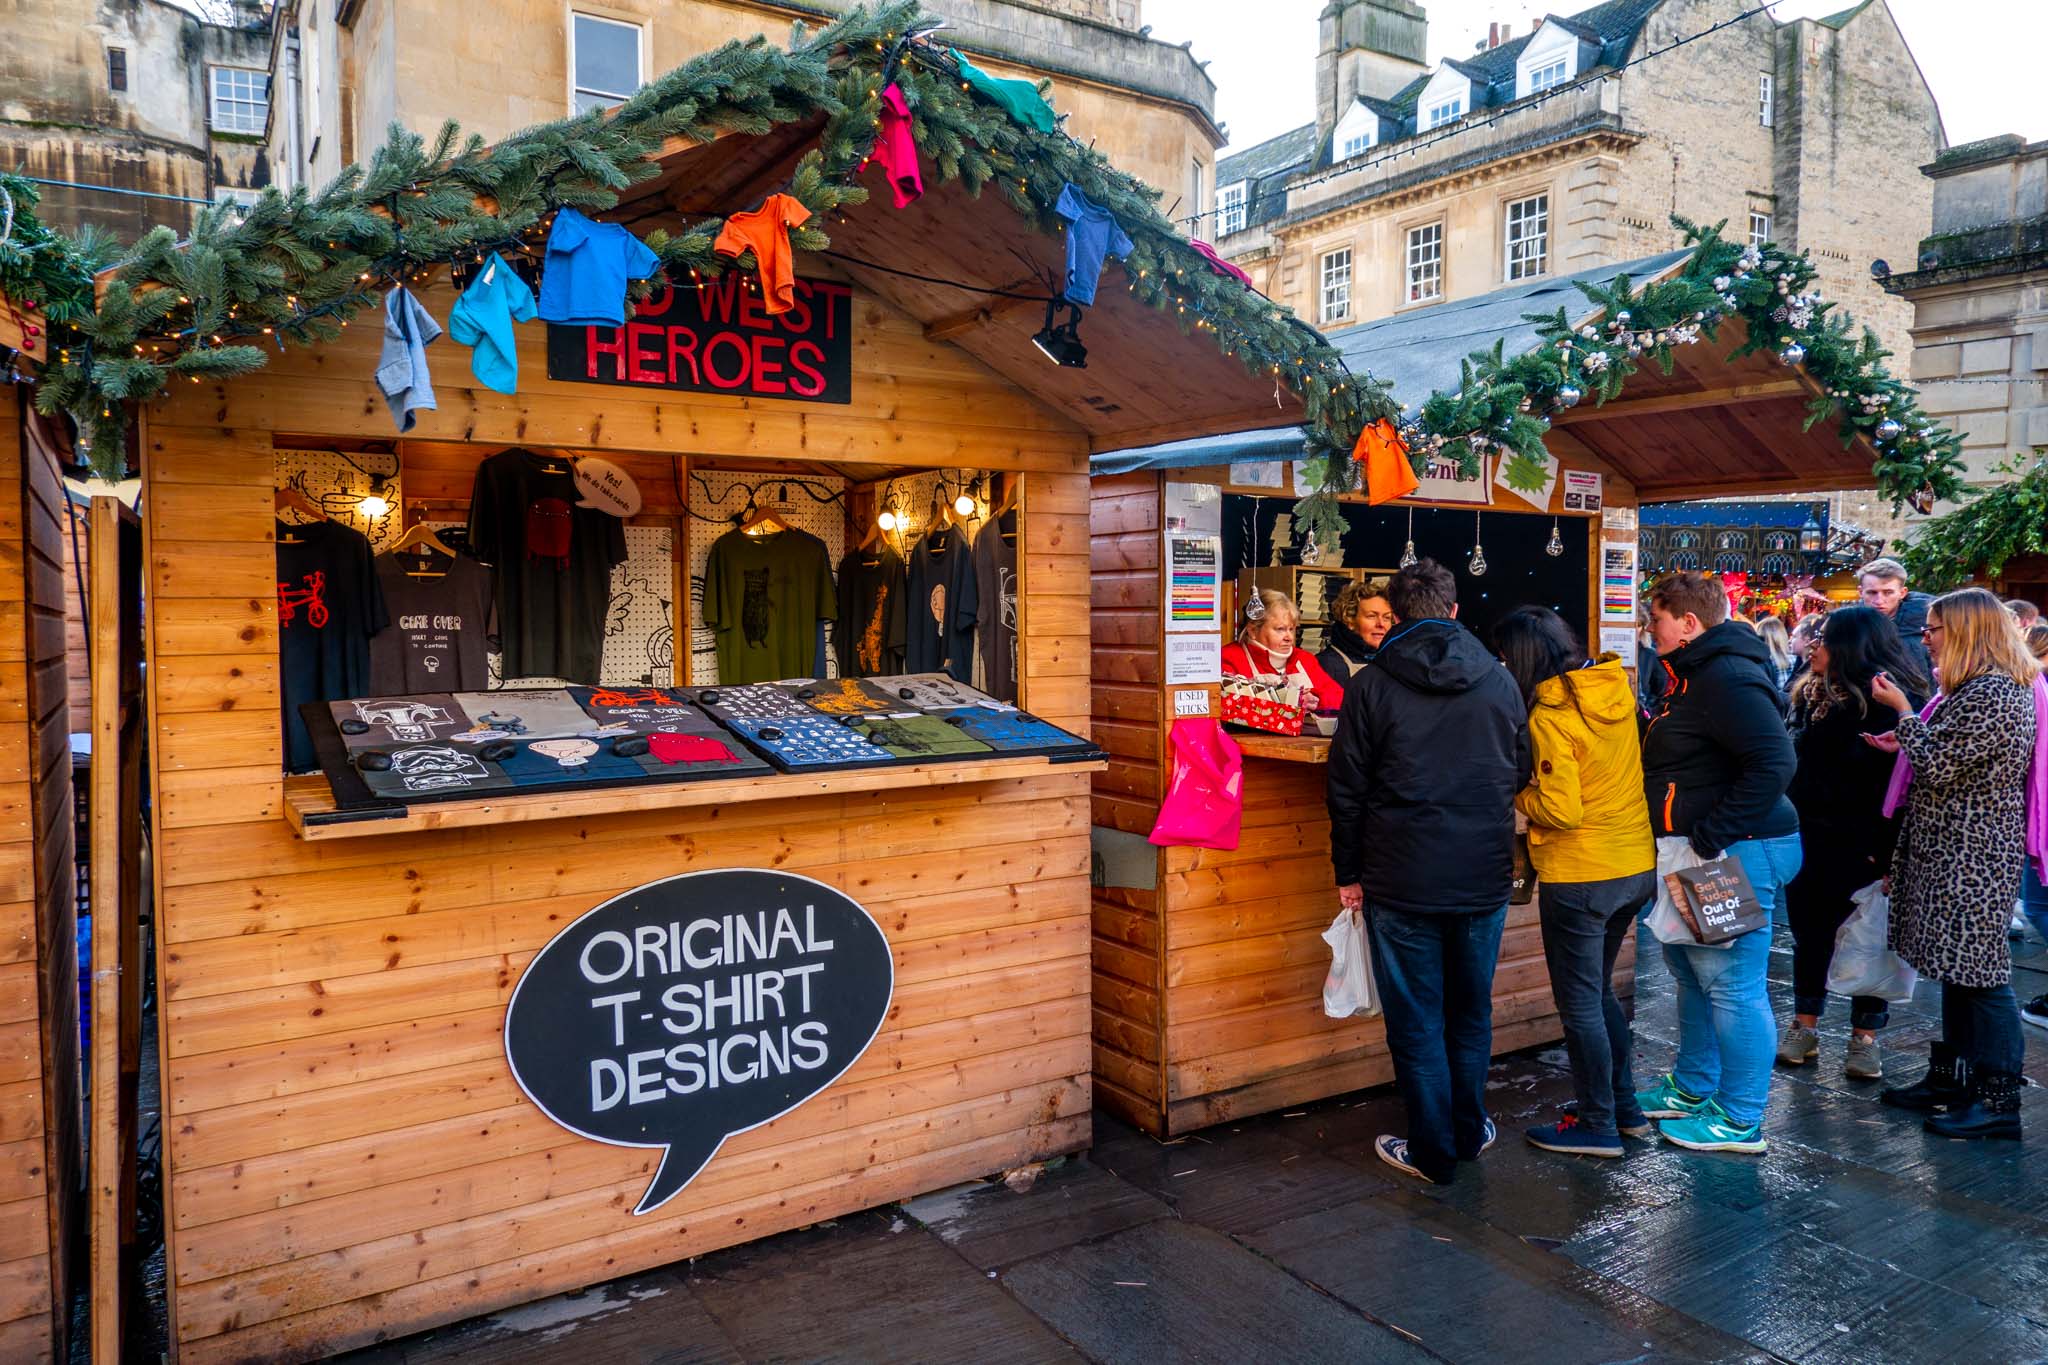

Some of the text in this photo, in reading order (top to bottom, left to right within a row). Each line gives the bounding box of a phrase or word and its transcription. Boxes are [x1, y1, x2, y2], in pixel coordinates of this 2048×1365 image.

[691, 267, 853, 340] WEST
[585, 322, 828, 397] HEROES
[582, 471, 592, 482] We
[591, 479, 600, 489] do
[600, 485, 614, 498] take
[604, 470, 623, 489] Yes!
[433, 615, 462, 630] OVER
[1177, 691, 1205, 701] USED
[1176, 703, 1209, 715] STICKS
[1694, 876, 1740, 893] Get The
[1698, 888, 1736, 904] Fudge
[1702, 896, 1742, 916] Out Of
[1706, 909, 1737, 927] Here!
[578, 904, 835, 985] ORIGINAL
[590, 1020, 829, 1113] DESIGNS
